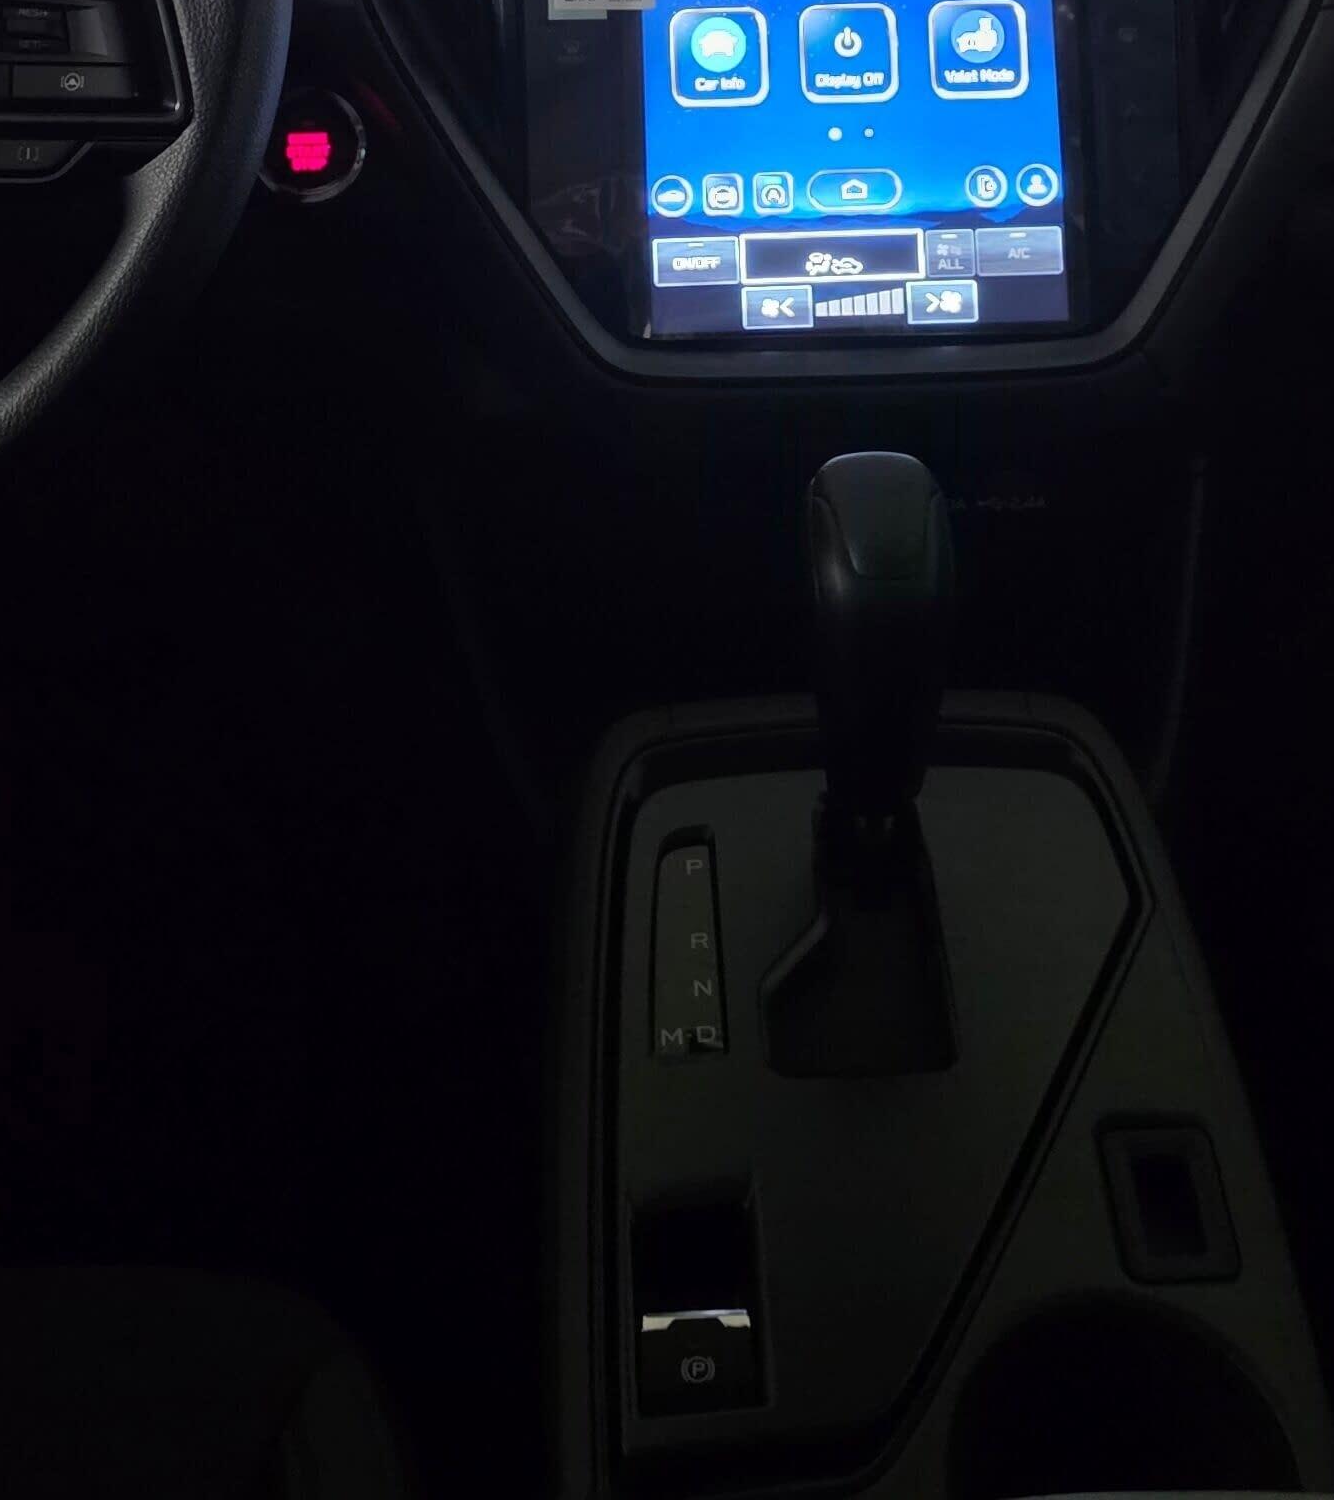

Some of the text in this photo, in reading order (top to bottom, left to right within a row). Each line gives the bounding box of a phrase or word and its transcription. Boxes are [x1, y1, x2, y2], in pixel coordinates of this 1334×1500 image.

[814, 71, 885, 89] Display Off
[944, 68, 1015, 83] Valet Mode
[694, 77, 746, 92] Car Info
[1007, 247, 1031, 260] A/C
[671, 256, 722, 272] ON/OFF
[937, 258, 964, 271] ALL
[685, 859, 704, 876] P
[690, 931, 710, 949] R
[692, 979, 713, 997] N
